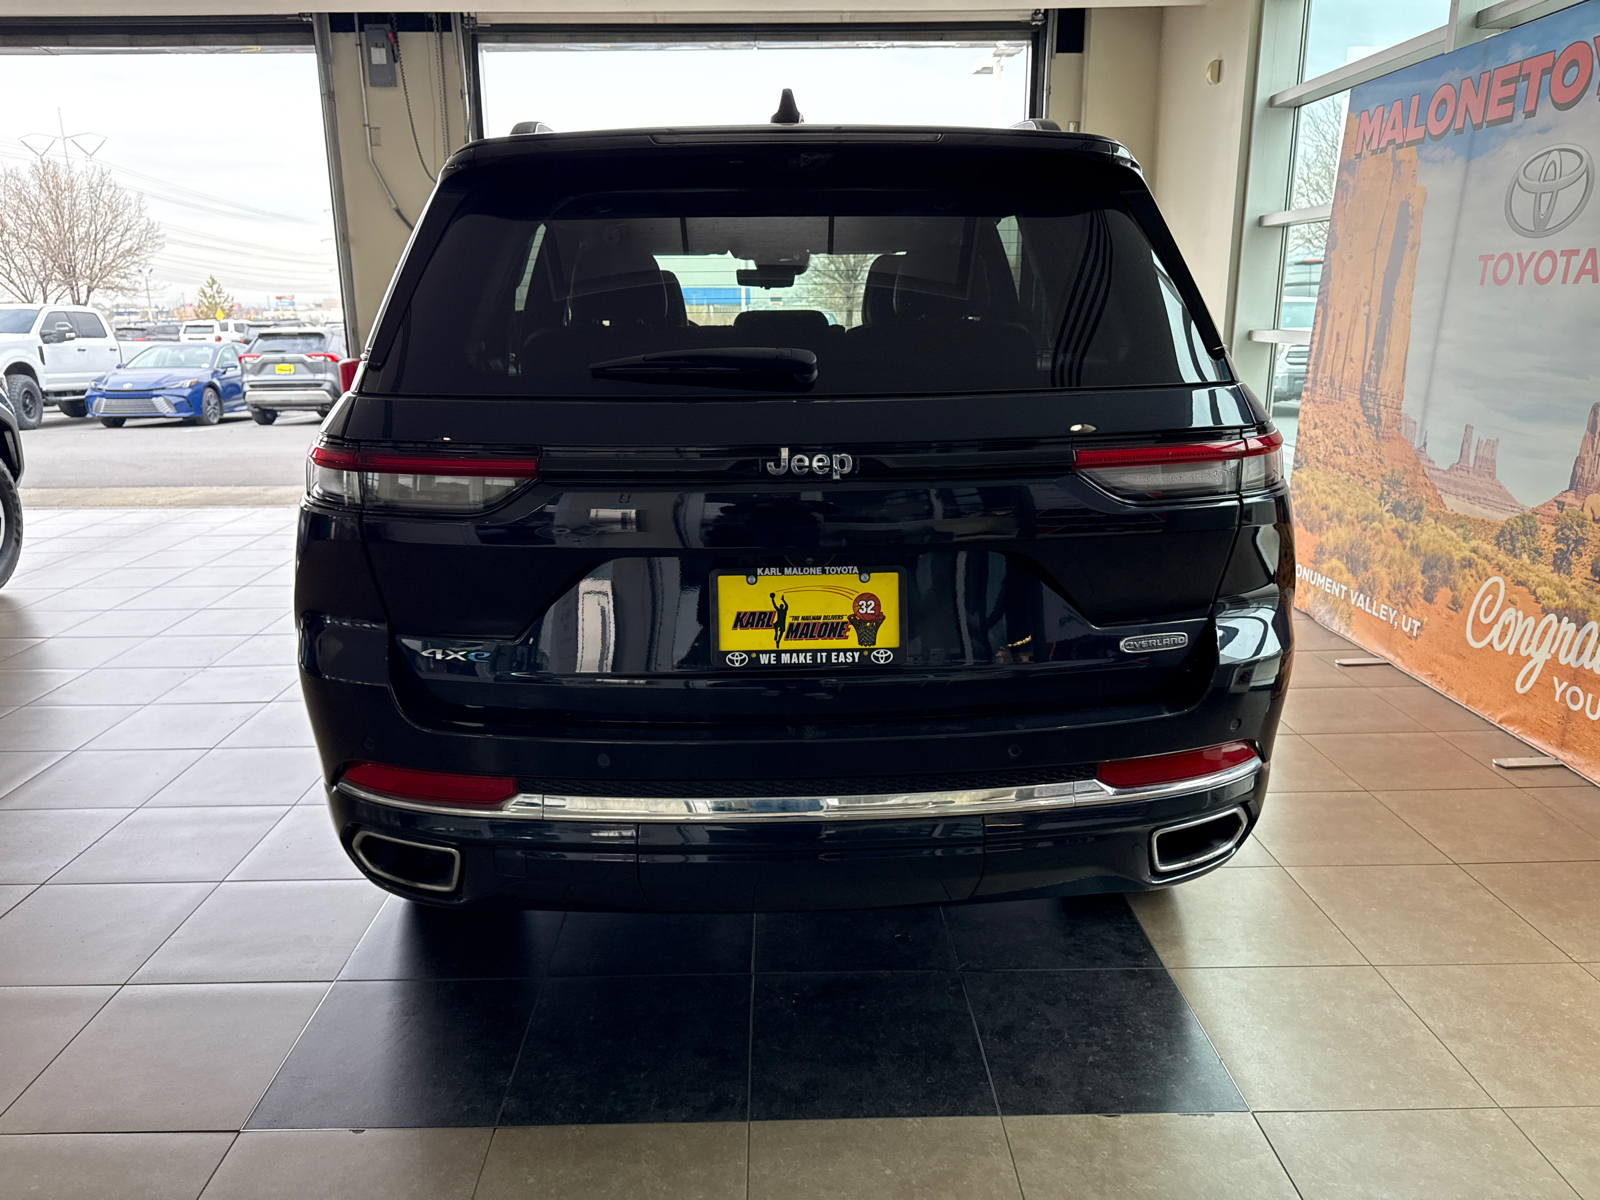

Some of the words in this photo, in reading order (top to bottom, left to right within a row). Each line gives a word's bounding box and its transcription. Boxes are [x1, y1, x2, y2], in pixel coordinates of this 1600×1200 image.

[1354, 35, 1600, 159] MALONETO
[1477, 247, 1600, 287] TOYOTA
[766, 447, 853, 480] Jeep
[757, 567, 782, 576] KARL
[784, 567, 822, 576] MALONE
[824, 566, 859, 575] TOYOTA
[858, 600, 875, 614] 32
[1295, 563, 1348, 600] ONUMENT
[1350, 588, 1398, 630] VALLEY,
[1401, 614, 1421, 637] UT
[732, 611, 777, 630] KARL
[784, 620, 850, 641] MALONE
[1125, 636, 1185, 649] OVERLAND
[1466, 575, 1600, 694] Congra
[759, 653, 777, 664] WE
[781, 652, 813, 664] MAKE
[817, 652, 828, 663] IT
[832, 651, 861, 663] EASY
[1553, 676, 1600, 720] YOU
